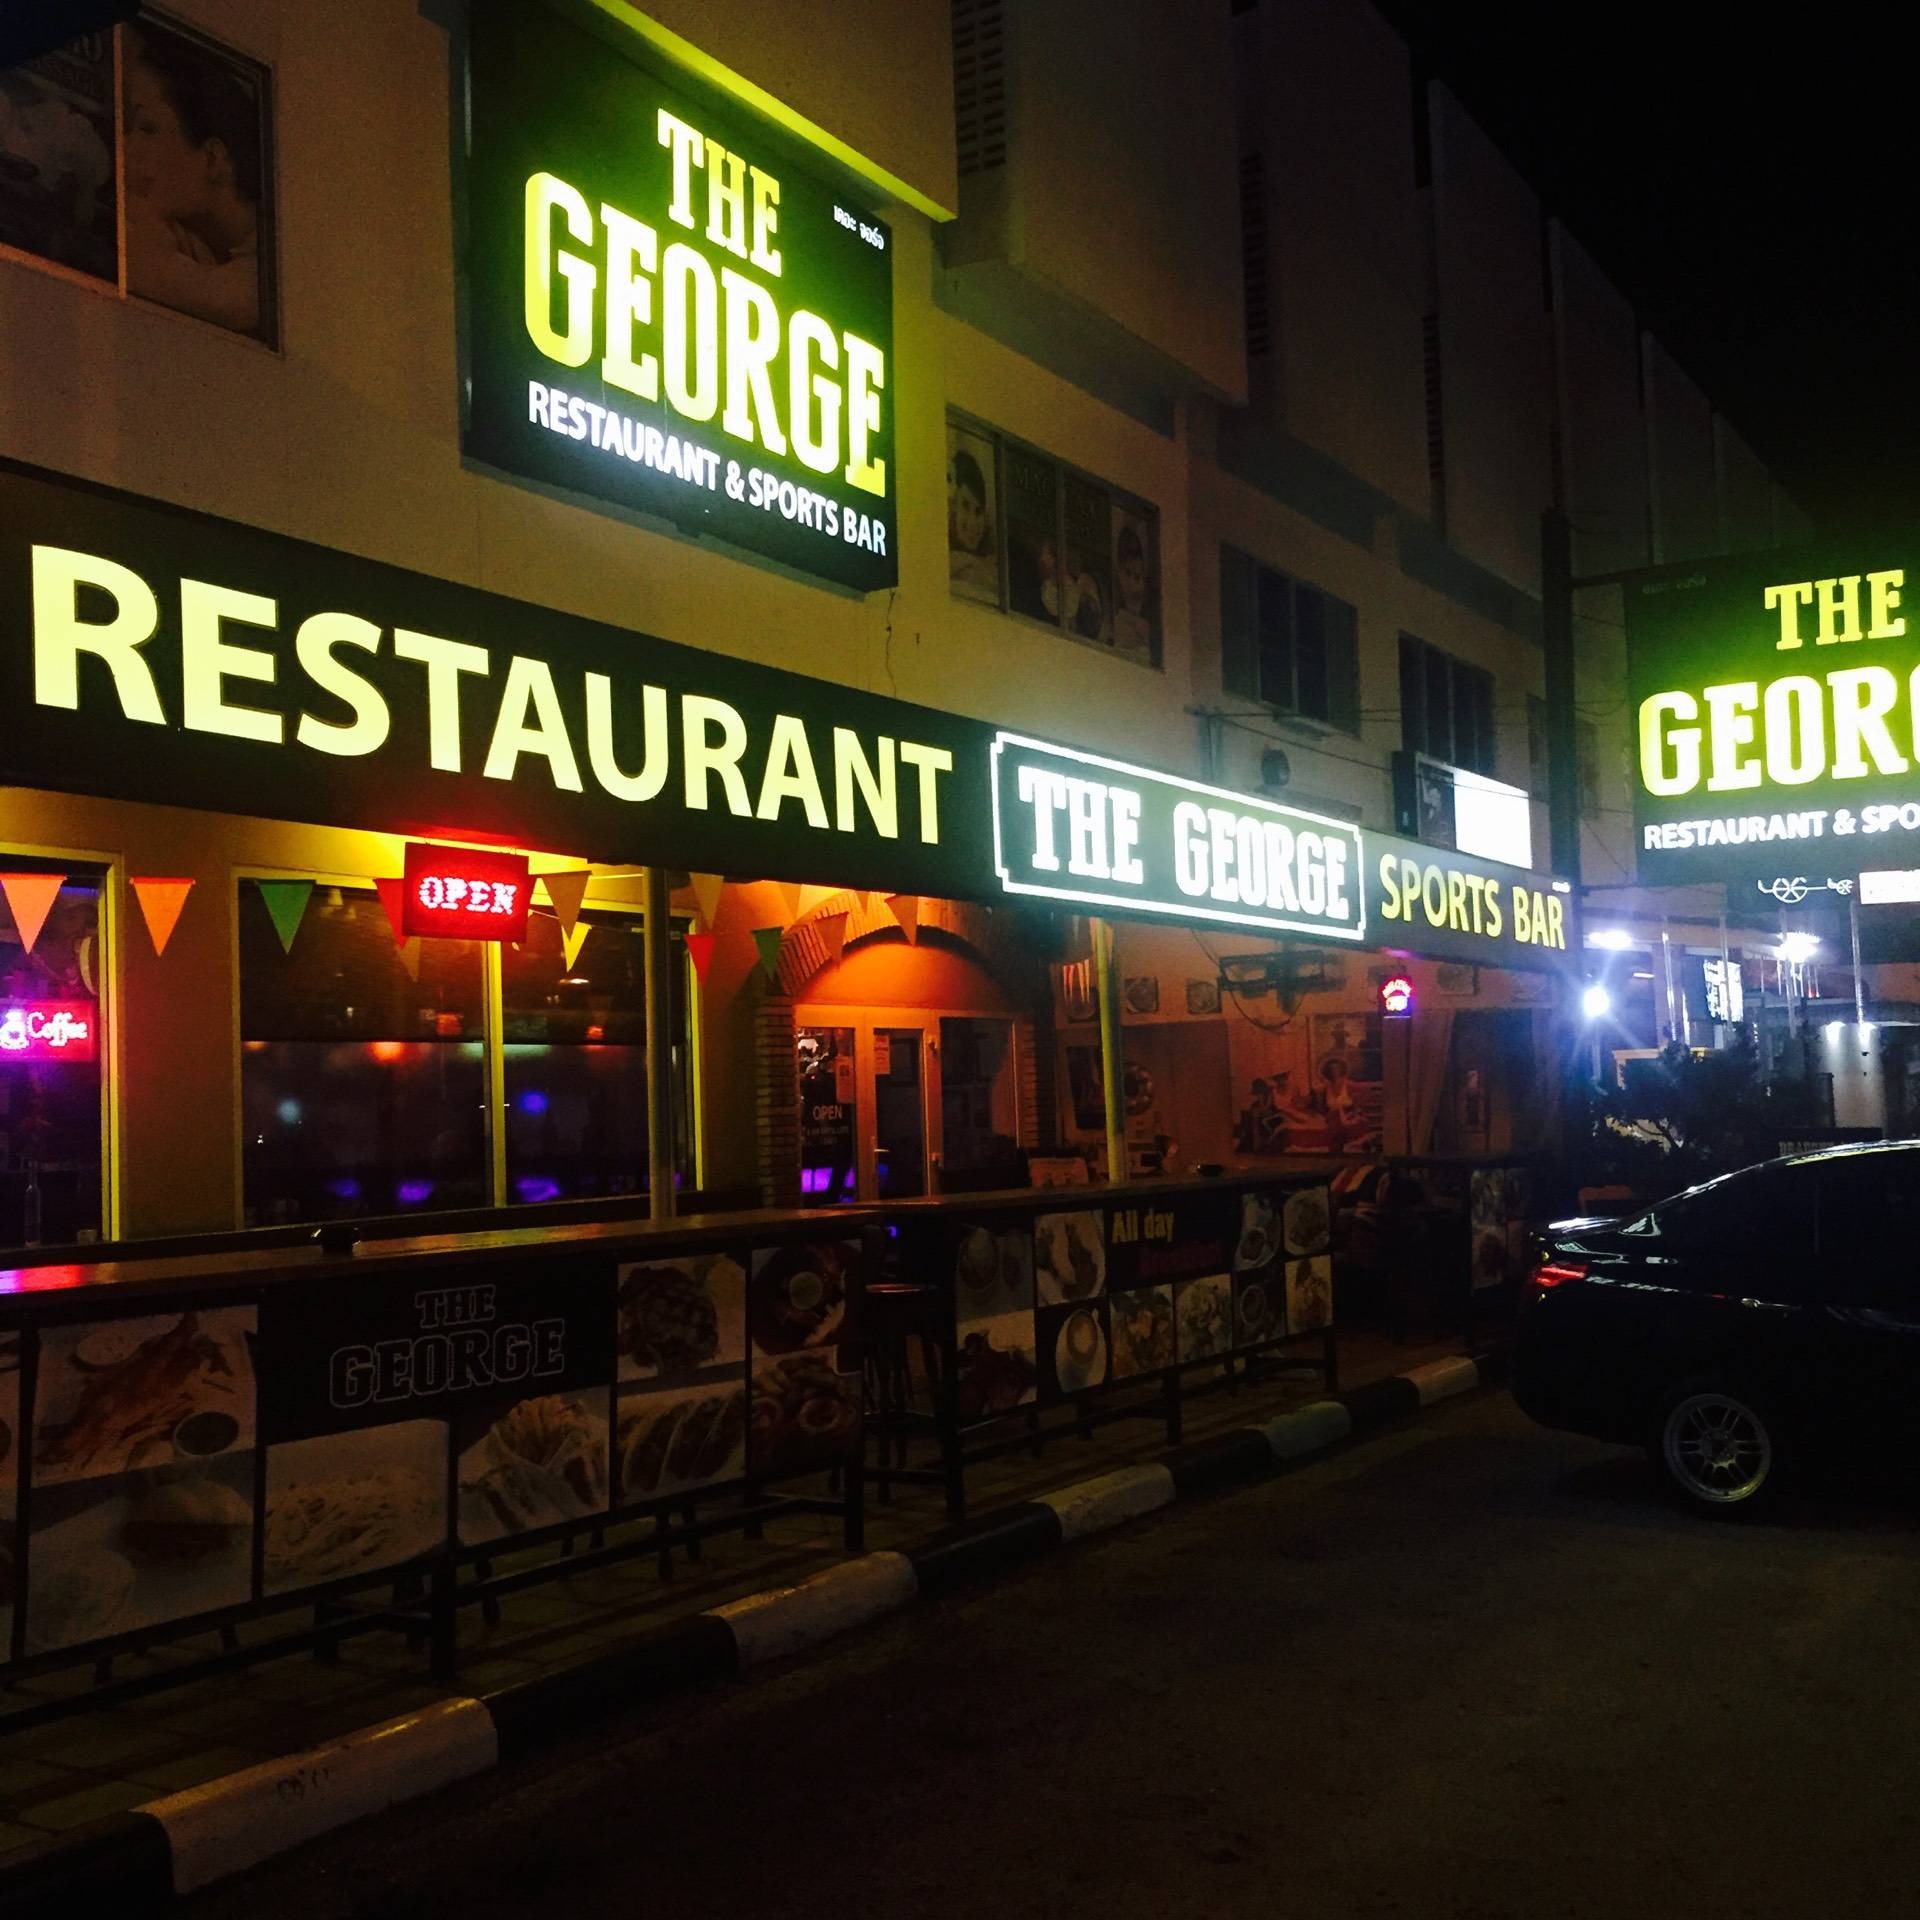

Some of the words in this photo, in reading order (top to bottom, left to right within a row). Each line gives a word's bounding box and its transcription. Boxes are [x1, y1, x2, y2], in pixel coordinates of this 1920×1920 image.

[657, 107, 781, 277] THE
[524, 171, 886, 497] GEORGE
[528, 379, 720, 491] RESTAURANT
[725, 459, 745, 501] &
[749, 470, 839, 537] SPORTS
[843, 513, 887, 556] BAR
[1764, 568, 1906, 650] THE
[32, 544, 953, 845] RESTAURANT
[1638, 662, 1920, 797] GEOR
[1017, 765, 1145, 885] THE
[1172, 801, 1350, 920] GEORGE
[1643, 810, 1828, 850] RESTAURANT
[1832, 808, 1857, 836] &
[418, 874, 516, 916] OPEN
[1378, 852, 1502, 938] SPORTS
[1512, 886, 1566, 950] BAR
[812, 1105, 843, 1121] OPEN
[1111, 1209, 1139, 1243] All
[1143, 1206, 1175, 1243] day
[415, 1284, 497, 1330] THE
[328, 1318, 566, 1409] GEORGE
